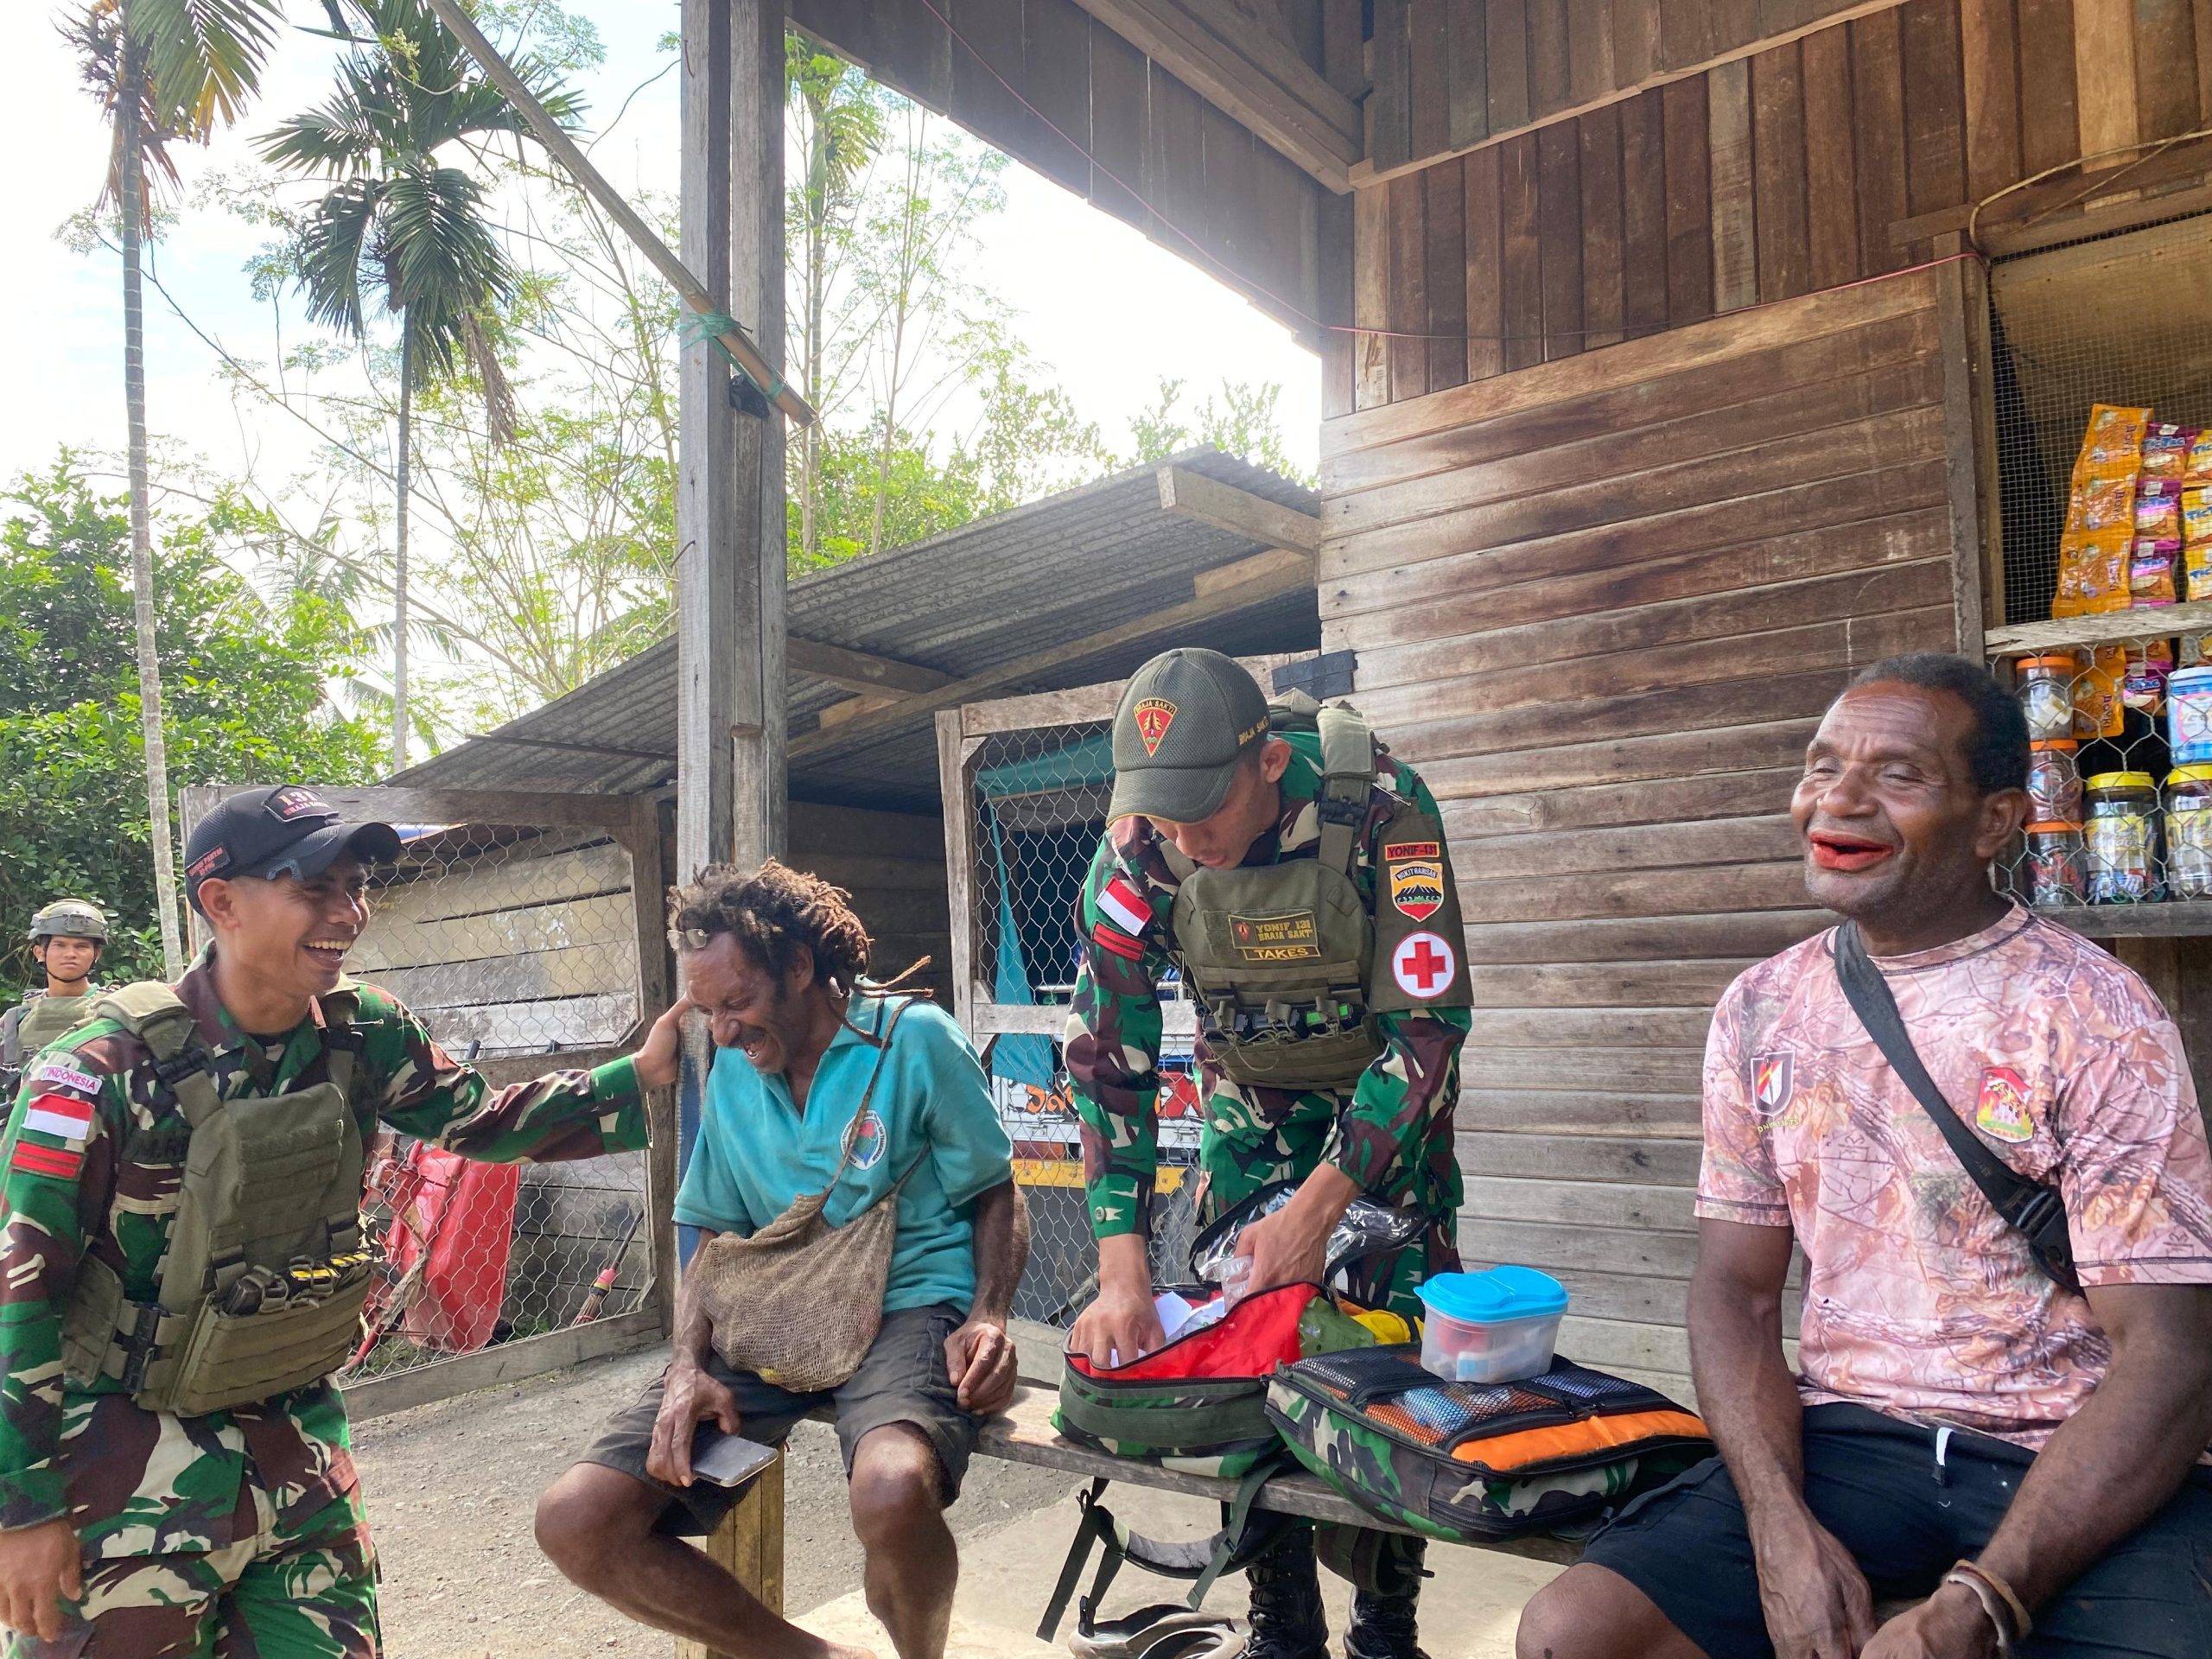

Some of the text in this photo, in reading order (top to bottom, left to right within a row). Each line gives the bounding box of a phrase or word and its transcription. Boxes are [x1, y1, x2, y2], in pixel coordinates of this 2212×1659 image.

[277, 791, 317, 806] 131
[1255, 919, 1311, 933] YONIF 131
[1258, 931, 1285, 942] BRAJA
[1254, 947, 1309, 959] TAKES
[47, 1067, 96, 1090] INDONESIA
